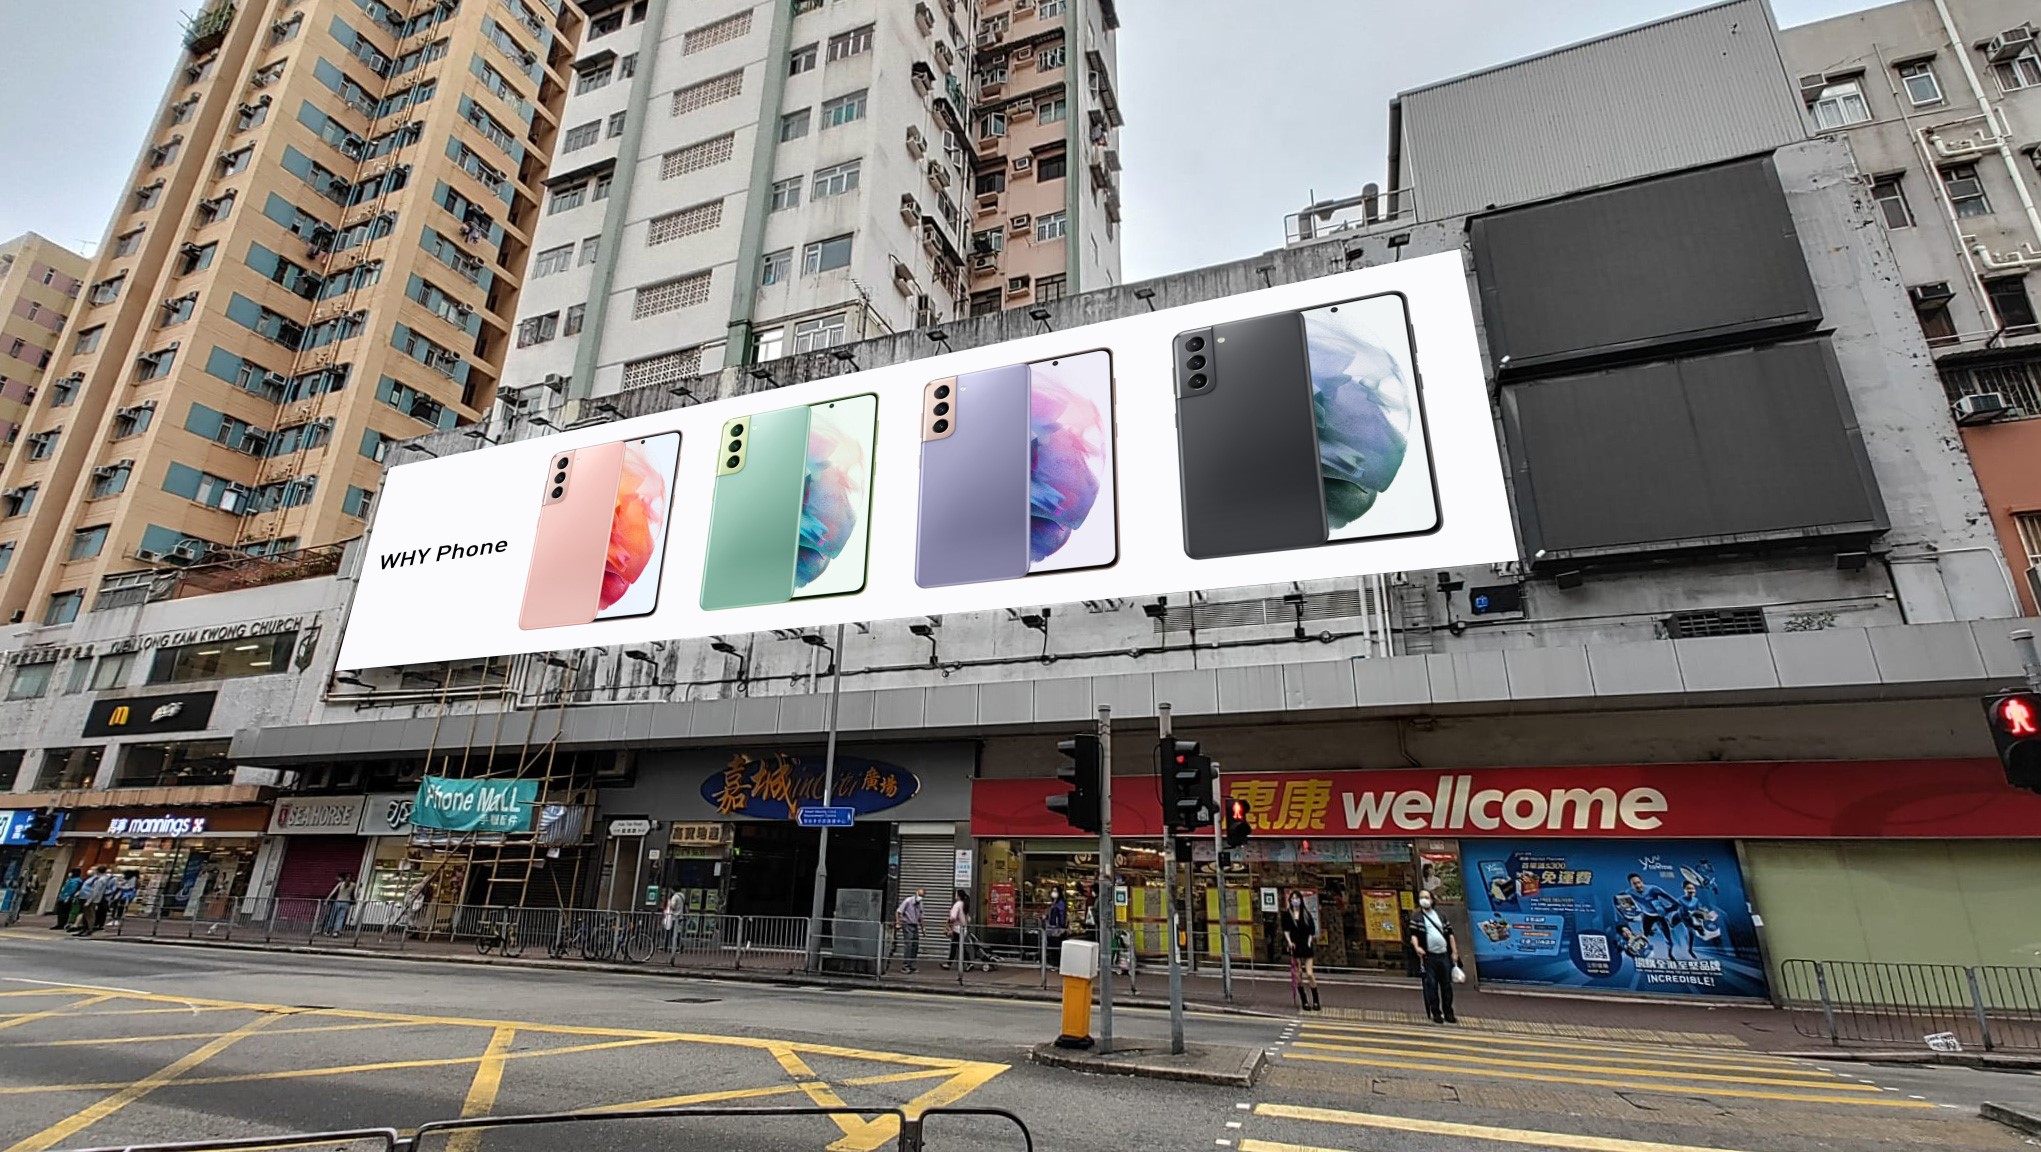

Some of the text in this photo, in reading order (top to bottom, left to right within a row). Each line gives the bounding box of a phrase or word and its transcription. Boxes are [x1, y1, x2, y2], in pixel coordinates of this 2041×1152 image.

[381, 540, 508, 570] WHY Phone
[138, 635, 168, 650] LONG
[172, 630, 196, 645] KAM
[200, 624, 246, 641] KWONG
[250, 617, 303, 636] CHURCH
[425, 783, 473, 812] Phone
[711, 753, 799, 818] 嘉城
[861, 766, 898, 798] 廣場
[1223, 780, 1333, 830] 惠康
[1342, 775, 1668, 830] wellcome
[129, 814, 190, 837] mannings
[1541, 870, 1591, 885] 免運費
[1648, 974, 1715, 987] INCREDIBLE!
